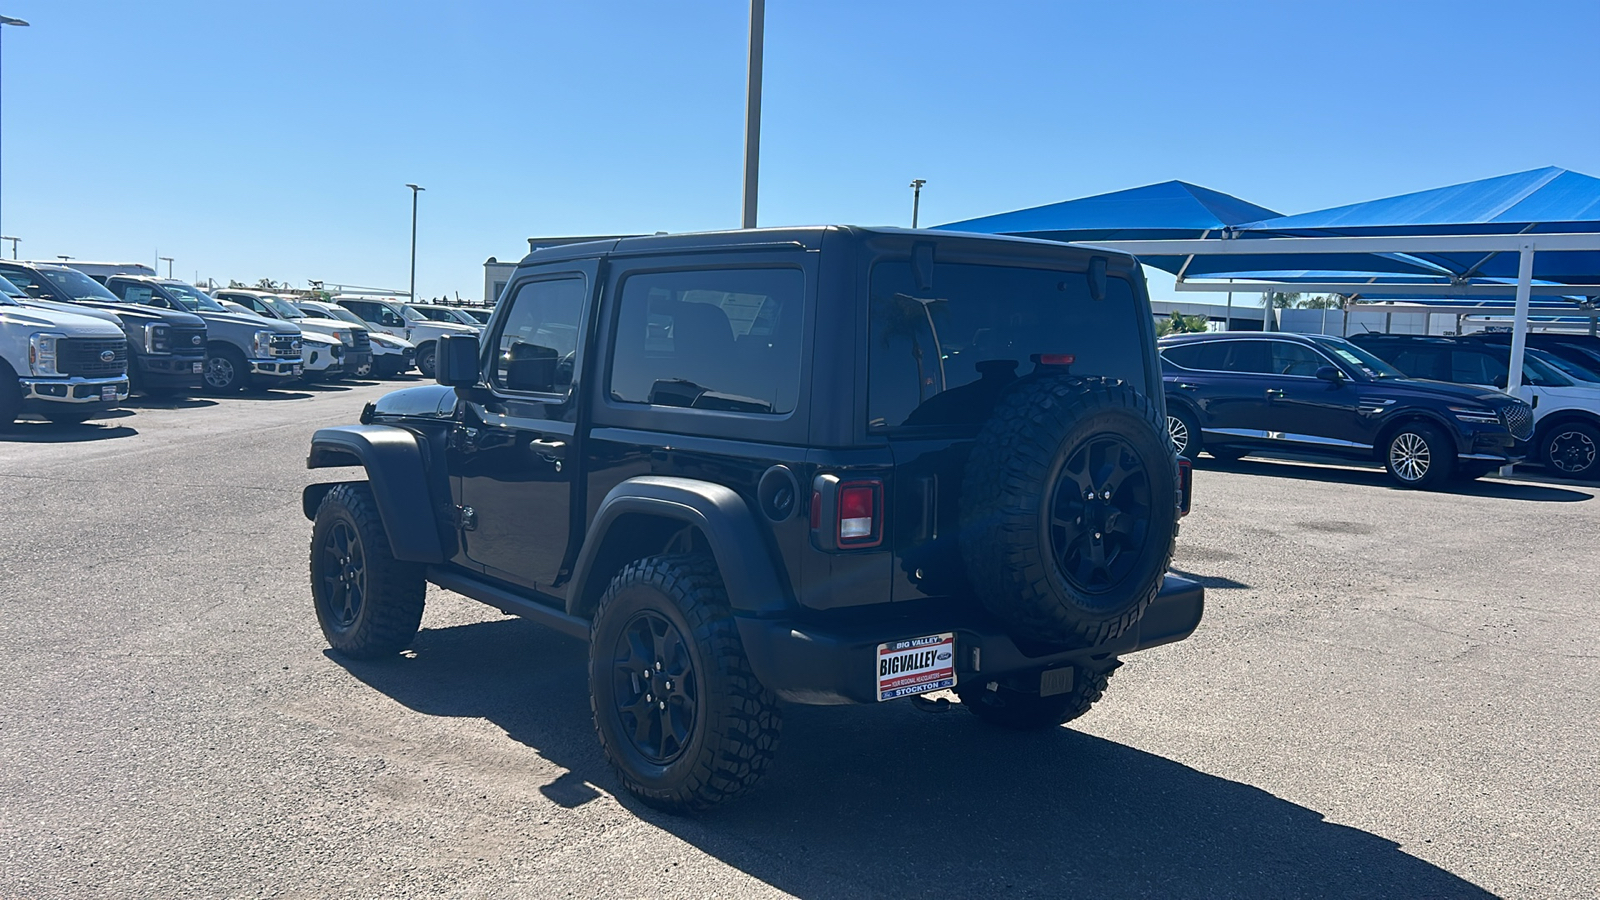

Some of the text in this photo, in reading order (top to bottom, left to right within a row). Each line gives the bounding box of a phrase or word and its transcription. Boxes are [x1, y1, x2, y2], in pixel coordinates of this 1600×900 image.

[896, 637, 938, 649] BIG VALLEY
[880, 650, 937, 676] BIGVALLEY
[896, 682, 939, 696] STOCKTON
